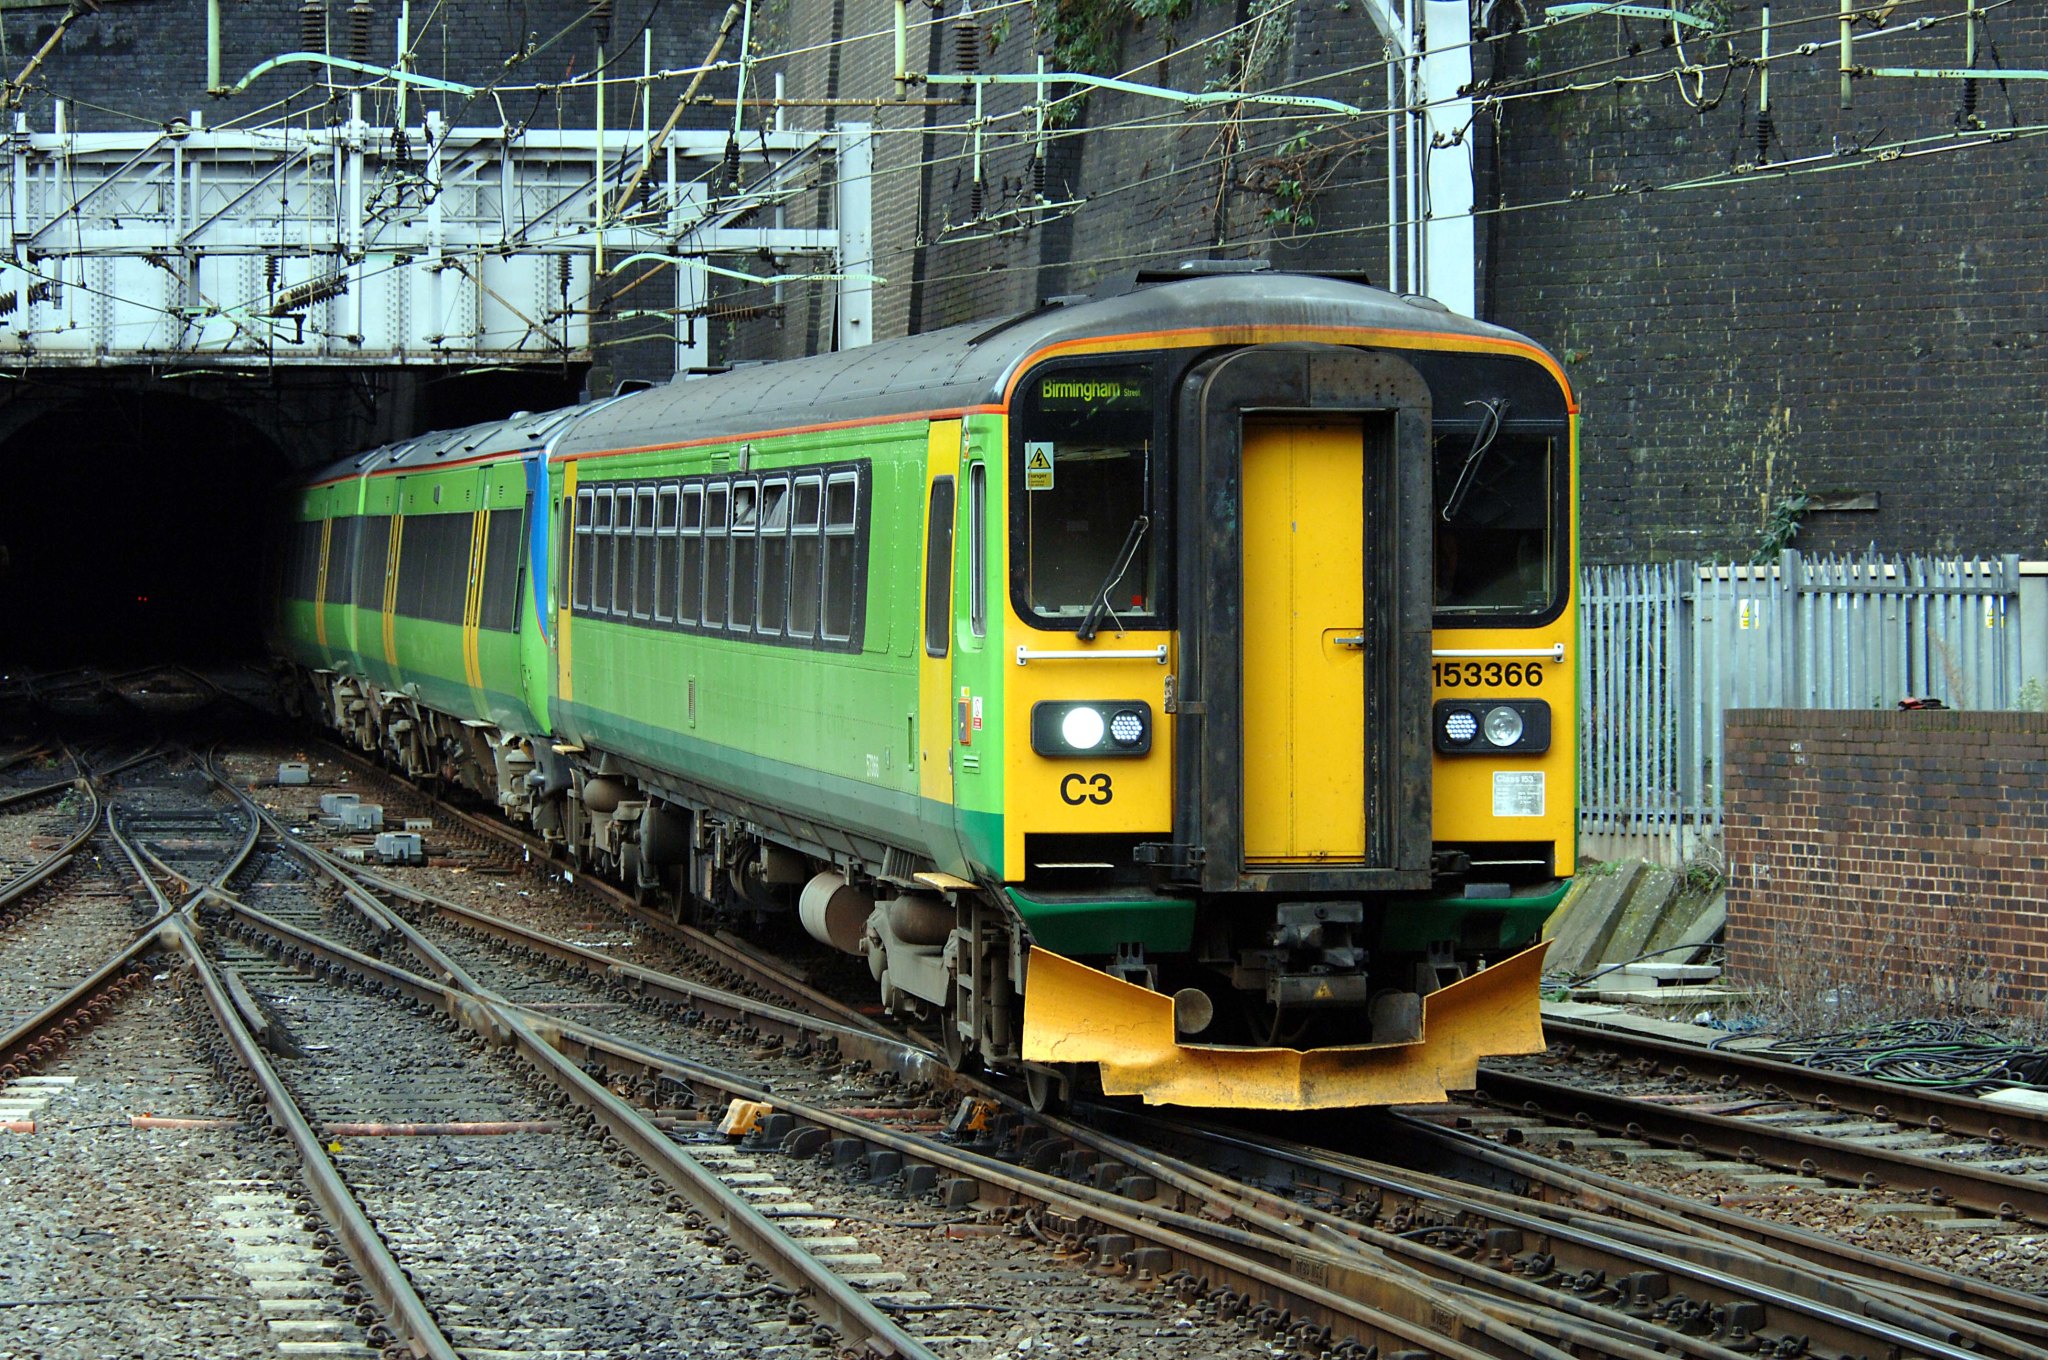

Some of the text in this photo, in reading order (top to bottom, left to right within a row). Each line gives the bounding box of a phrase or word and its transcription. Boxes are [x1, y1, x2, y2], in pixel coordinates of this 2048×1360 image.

[1043, 380, 1120, 401] Birmingham
[1432, 662, 1543, 687] 153366
[1060, 773, 1113, 805] C3
[1496, 774, 1534, 783] Class 153
